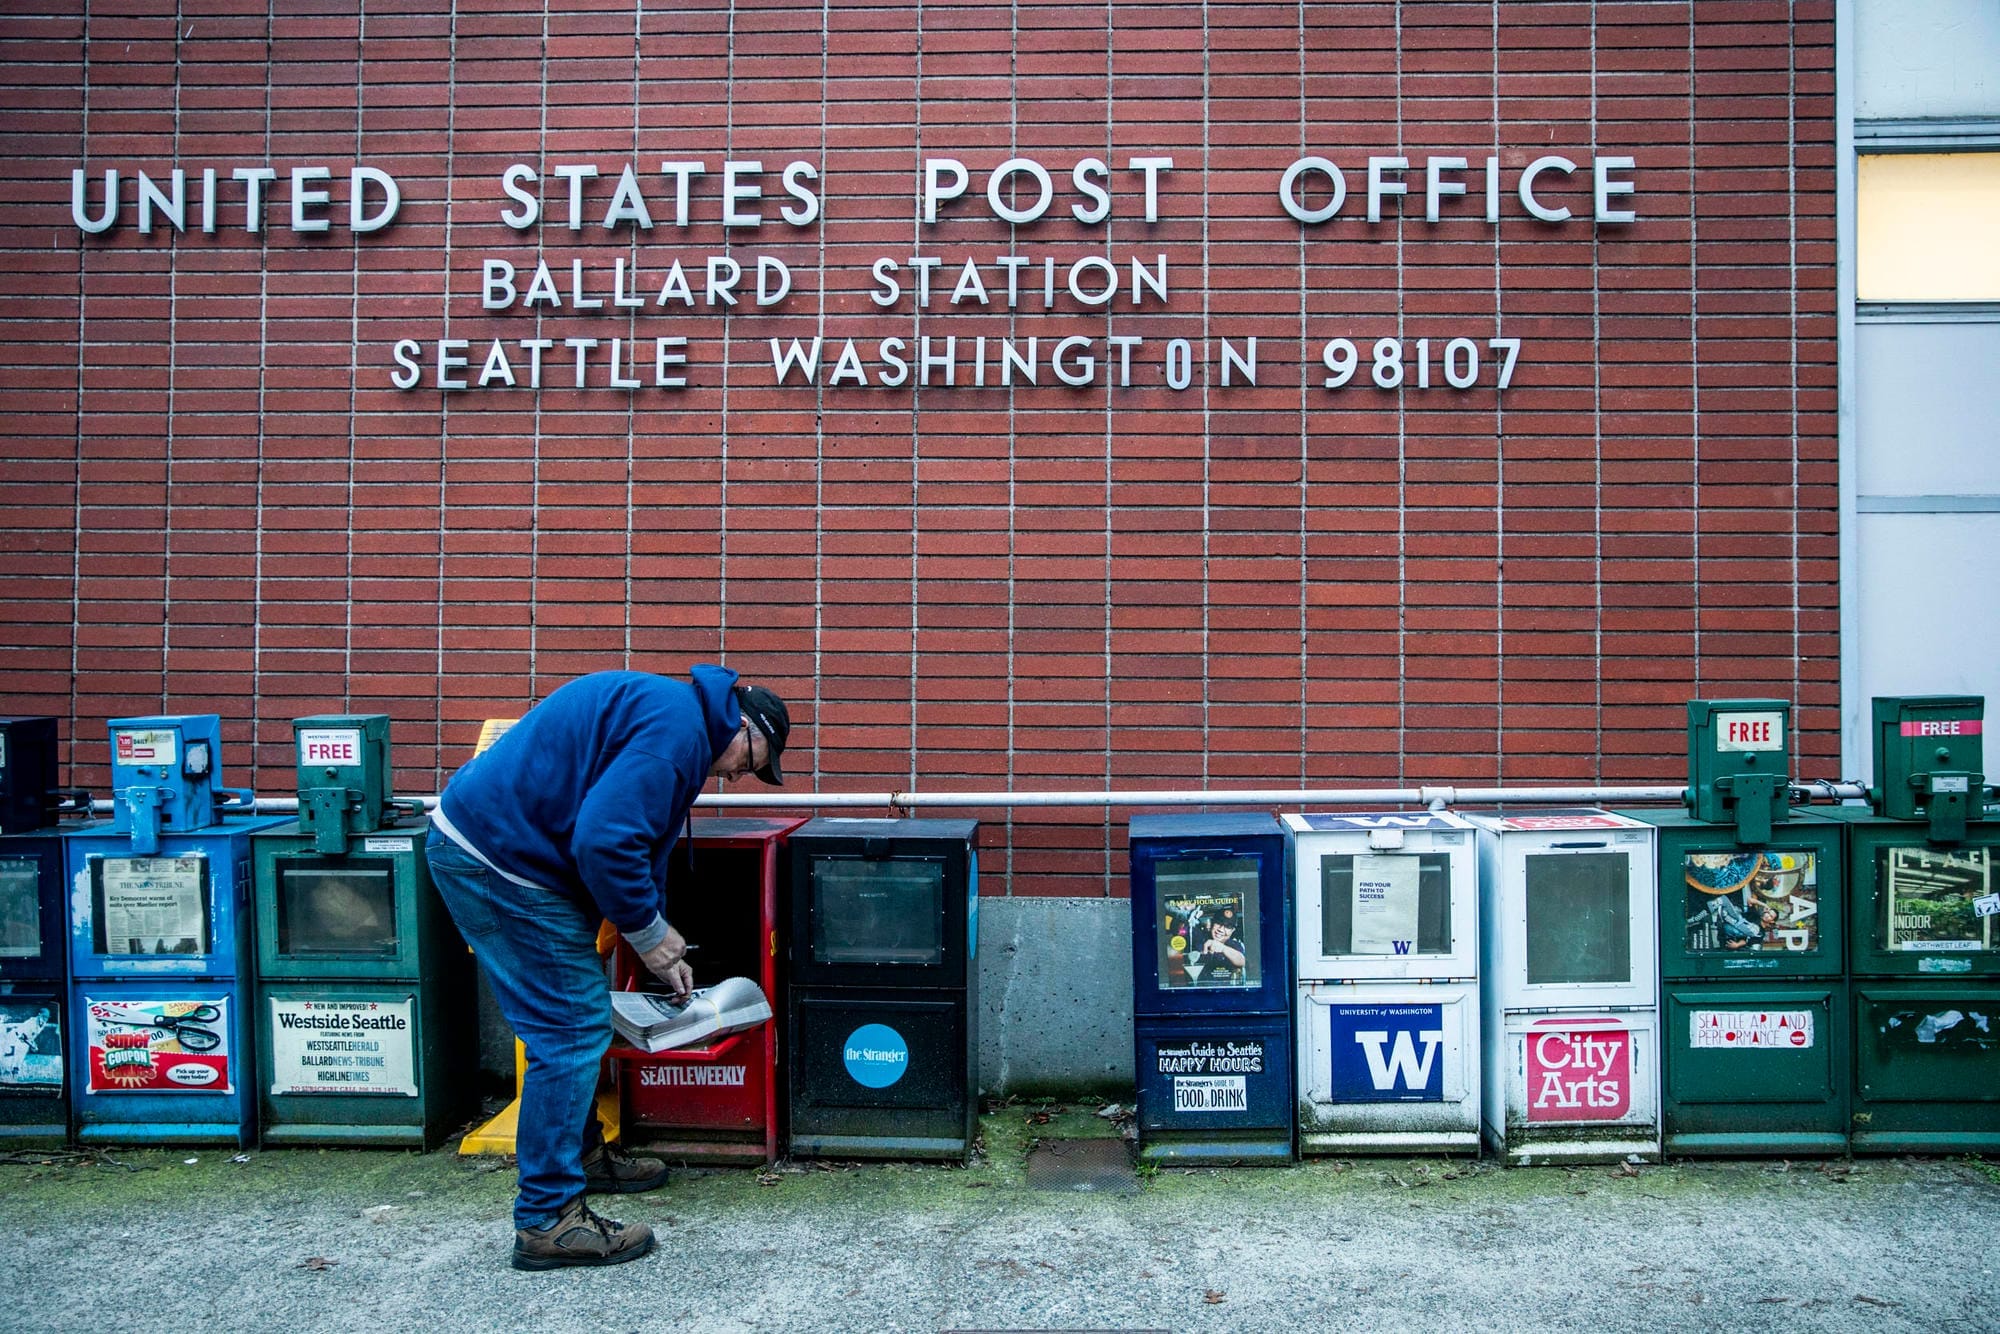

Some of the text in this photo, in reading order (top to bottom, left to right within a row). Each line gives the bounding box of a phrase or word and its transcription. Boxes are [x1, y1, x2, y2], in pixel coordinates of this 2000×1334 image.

[72, 155, 1636, 234] UNITED STATES POST OFFICE
[482, 254, 1168, 310] BALLARD STATION
[390, 336, 687, 390] SEATTLE
[1322, 337, 1522, 390] 98107
[1729, 721, 1770, 742] FREE
[1921, 721, 1961, 735] FREE
[308, 743, 353, 759] FREE
[1215, 897, 1239, 905] GUIDE
[1894, 915, 1931, 929] INDOOR
[1392, 940, 1412, 955] W
[278, 1013, 406, 1030] Westside Seattle
[1698, 1013, 1807, 1030] SEATTLE ART AND
[1698, 1030, 1780, 1046] PERFORMANCE
[846, 1048, 906, 1063] the Stranger
[1191, 1042, 1215, 1056] Guide
[1217, 1046, 1226, 1056] to
[1227, 1042, 1263, 1056] Seattle's
[1536, 1031, 1622, 1076] City
[108, 1050, 148, 1066] COUPON
[1159, 1057, 1262, 1072] HAPPY HOURS
[1355, 1030, 1442, 1090] W
[1533, 1071, 1620, 1108] Arts
[1176, 1089, 1204, 1108] FOOD
[1211, 1089, 1245, 1108] DRINK
